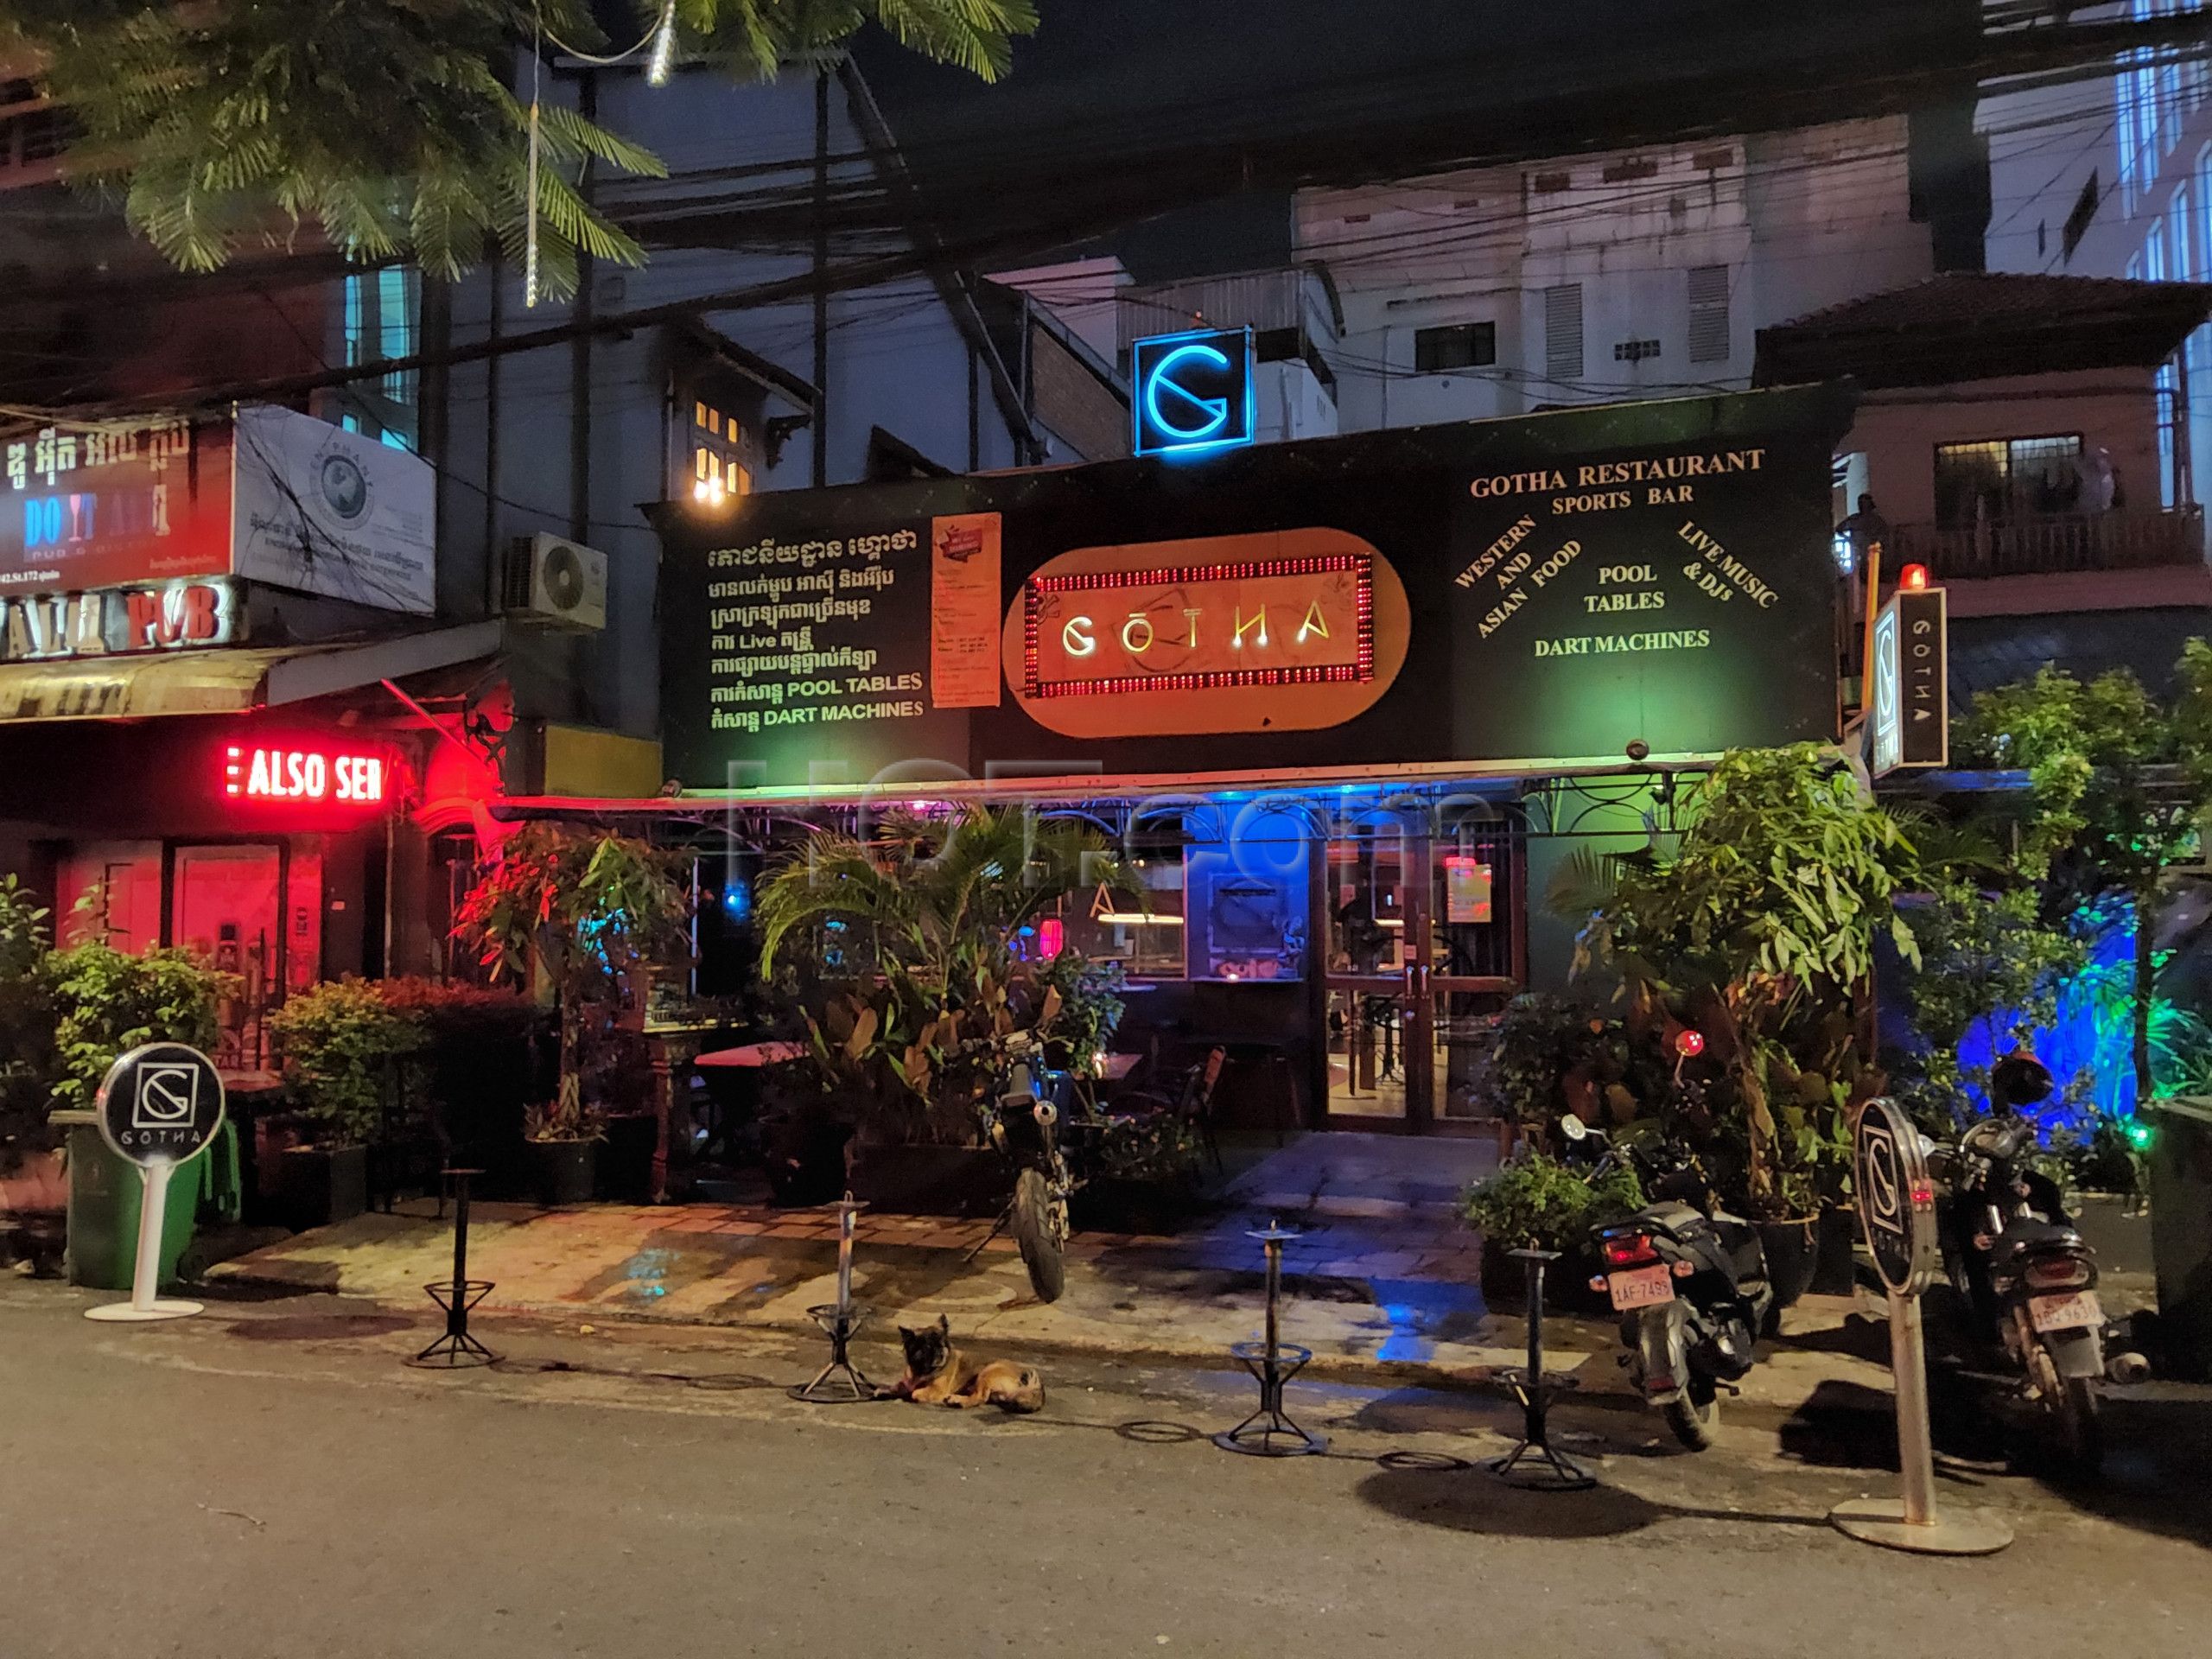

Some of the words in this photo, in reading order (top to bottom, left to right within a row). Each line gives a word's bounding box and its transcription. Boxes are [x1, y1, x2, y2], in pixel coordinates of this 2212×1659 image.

[1471, 468, 1567, 499] GOTHA
[1578, 448, 1765, 488] RESTAURANT
[1551, 491, 1632, 516] SPORTS
[1647, 485, 1694, 505] BAR
[1453, 513, 1538, 591] WESTERN
[1495, 551, 1533, 591] AND
[1677, 520, 1723, 563] LIVE
[1716, 555, 1780, 610] MUSIC
[1477, 587, 1529, 639] ASIAN
[1530, 539, 1582, 588] FOOD
[1598, 564, 1657, 585] POOL
[1682, 562, 1701, 581] &
[1697, 573, 1734, 602] DJs
[126, 584, 218, 648] PUB
[1584, 591, 1666, 613] TABLES
[739, 632, 777, 651] Live
[1535, 637, 1592, 658] DART
[1594, 629, 1710, 654] MACHINES
[787, 679, 842, 698] POOL
[845, 672, 923, 694] TABLES
[764, 707, 817, 726] DART
[821, 701, 924, 722] MACHINES
[247, 748, 326, 798] ALSO
